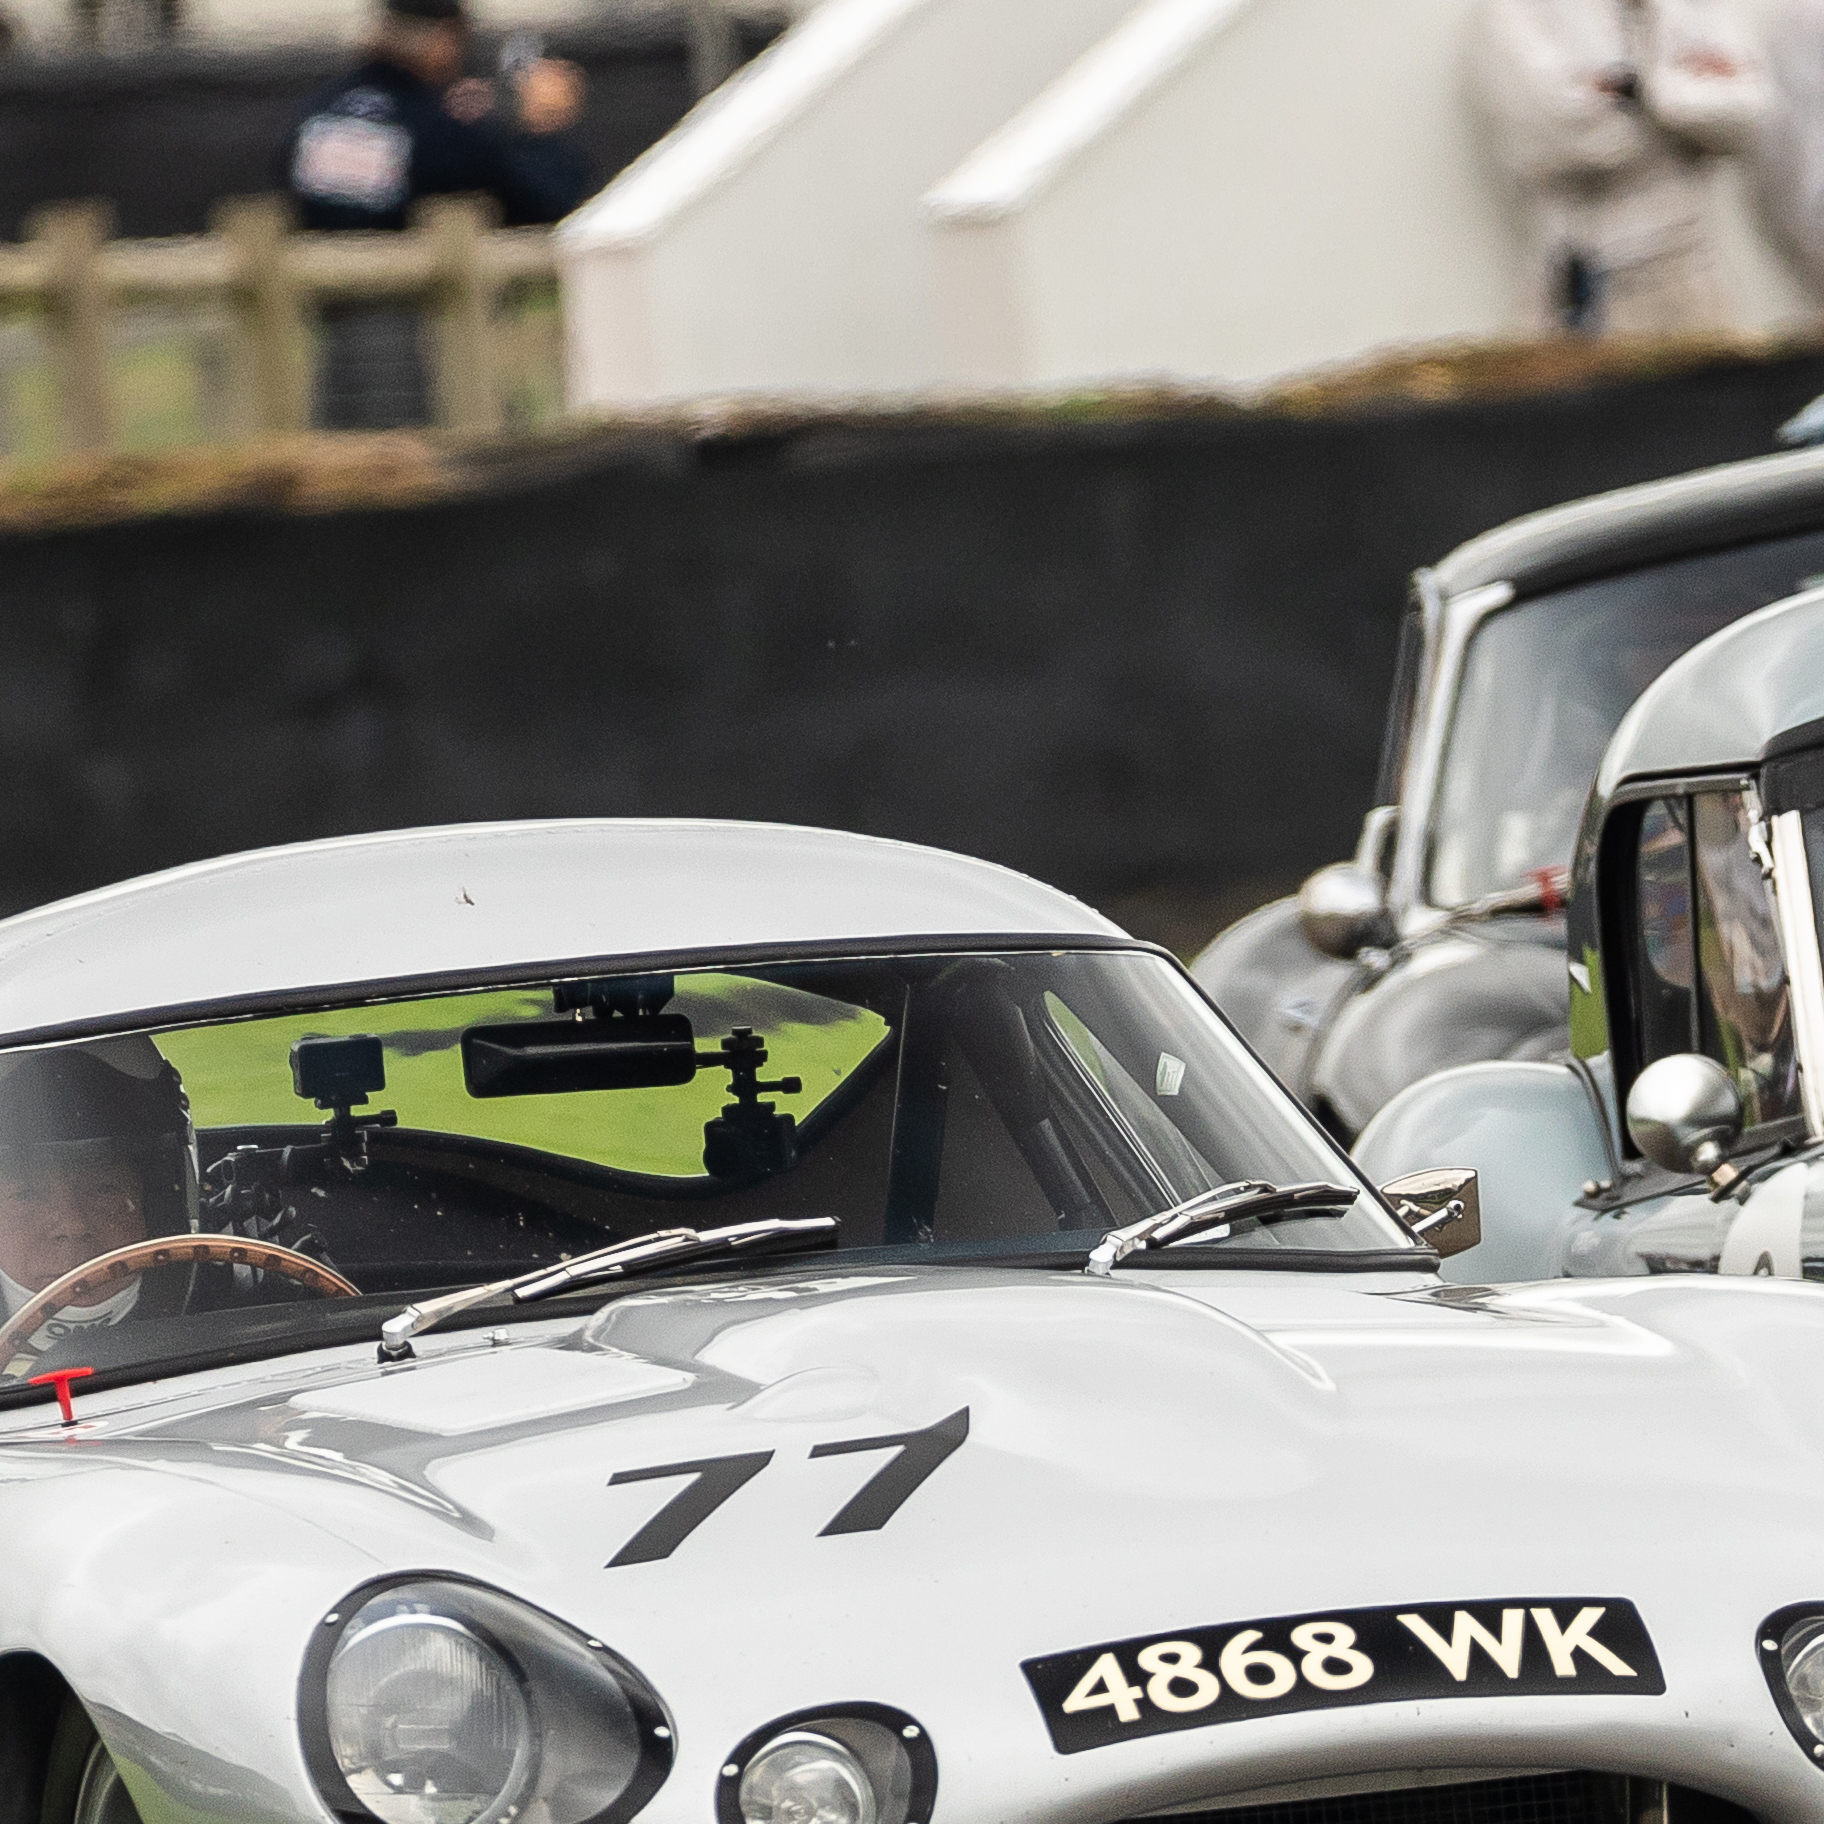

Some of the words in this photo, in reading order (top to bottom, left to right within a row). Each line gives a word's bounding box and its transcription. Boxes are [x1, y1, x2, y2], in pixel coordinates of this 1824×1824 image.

[603, 1405, 970, 1569] 77
[1062, 1621, 1374, 1723] 4868
[1397, 1607, 1638, 1682] WK
